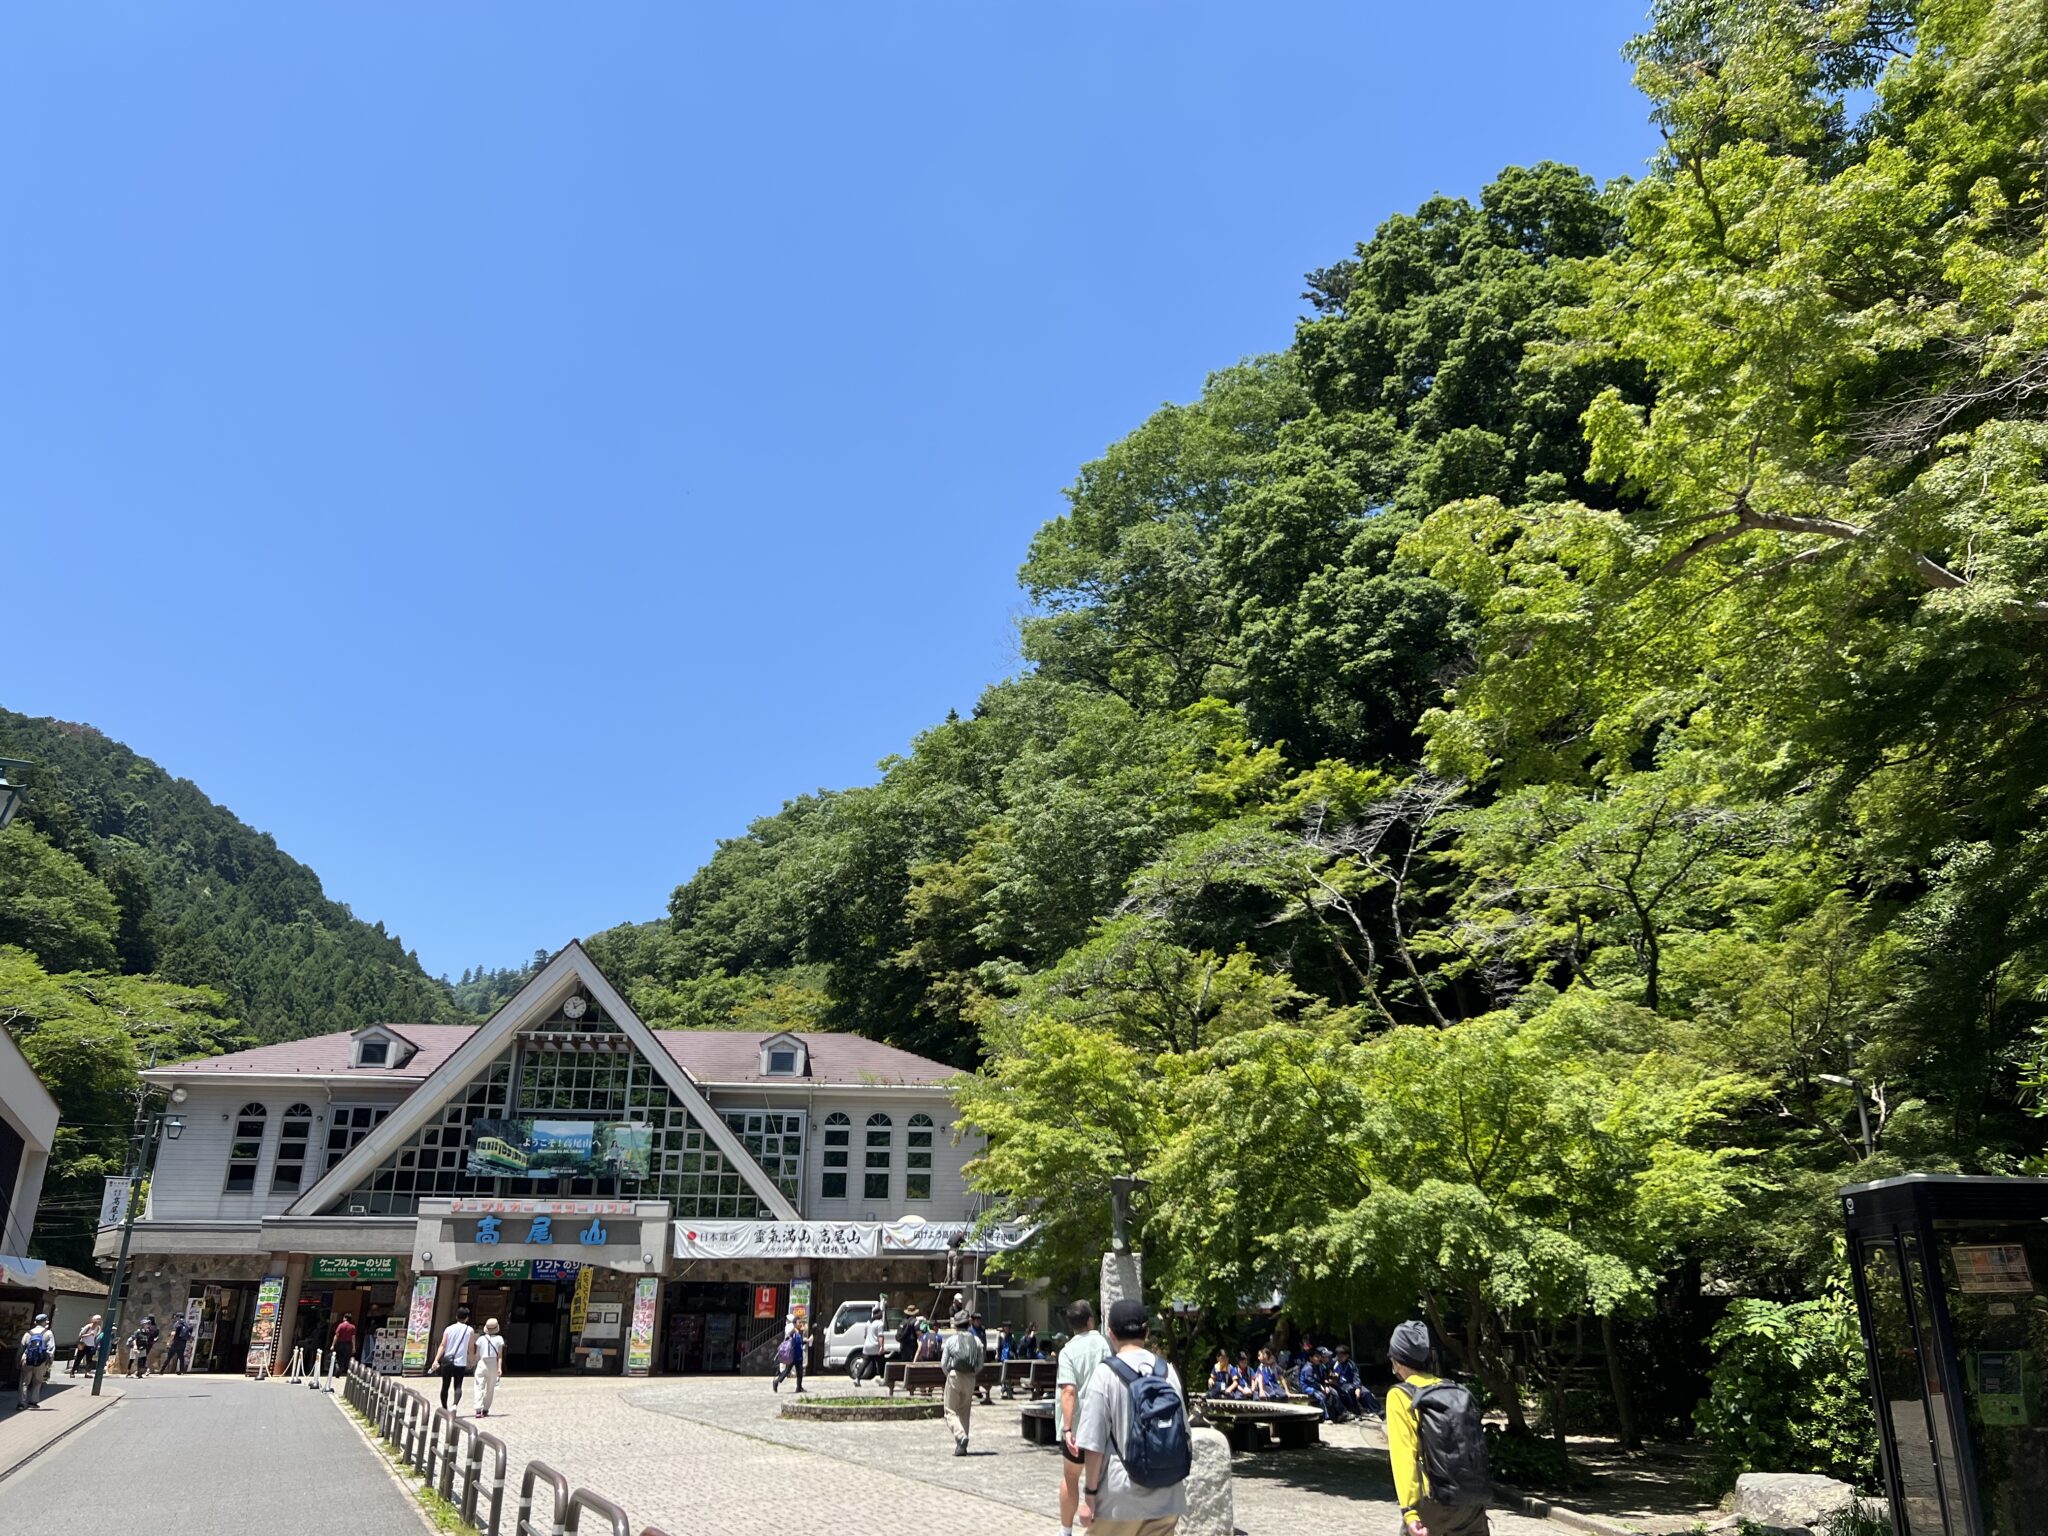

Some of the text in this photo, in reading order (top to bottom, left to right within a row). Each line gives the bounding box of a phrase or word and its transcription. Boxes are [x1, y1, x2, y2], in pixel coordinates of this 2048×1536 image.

[475, 1214, 608, 1246] 高尾山
[700, 1230, 738, 1243] 日本遺産
[818, 1228, 861, 1245] 高尾山
[319, 1258, 392, 1267] ケーブルカーのりば
